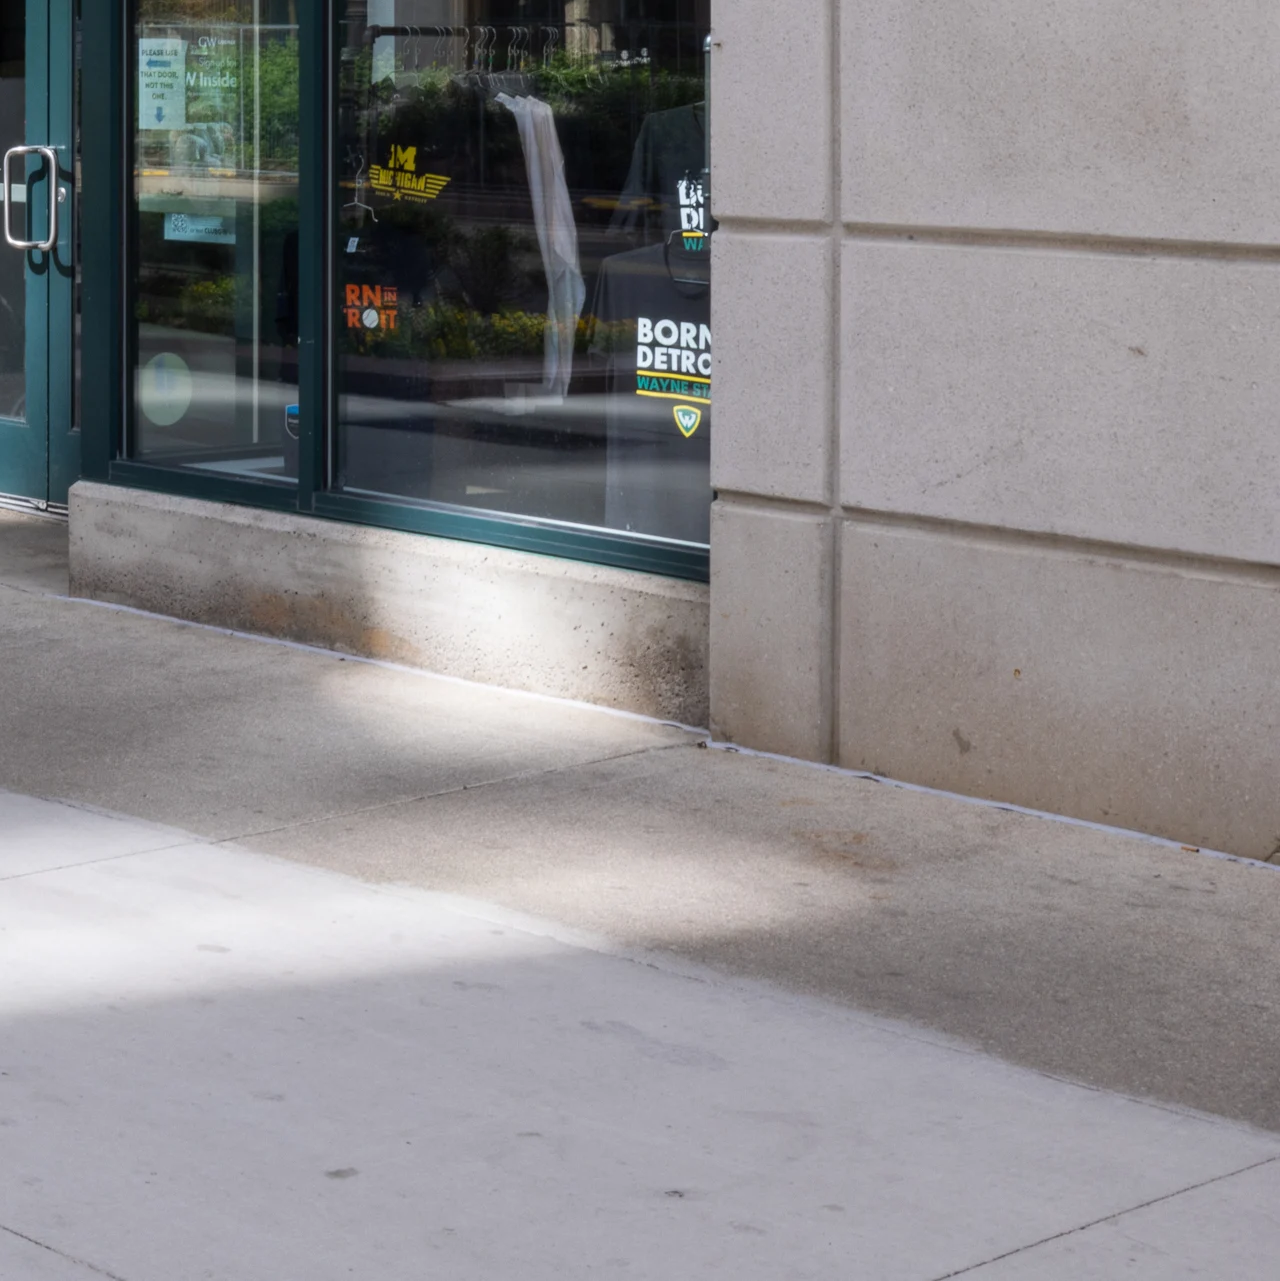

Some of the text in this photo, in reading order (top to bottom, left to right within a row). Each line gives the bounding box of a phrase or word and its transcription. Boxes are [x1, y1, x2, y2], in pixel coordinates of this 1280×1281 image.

[141, 49, 178, 57] PLEASE USE
[200, 71, 237, 88] Inside
[345, 284, 381, 307] RN
[636, 344, 712, 376] DETRO
[636, 375, 689, 395] WAYNE
